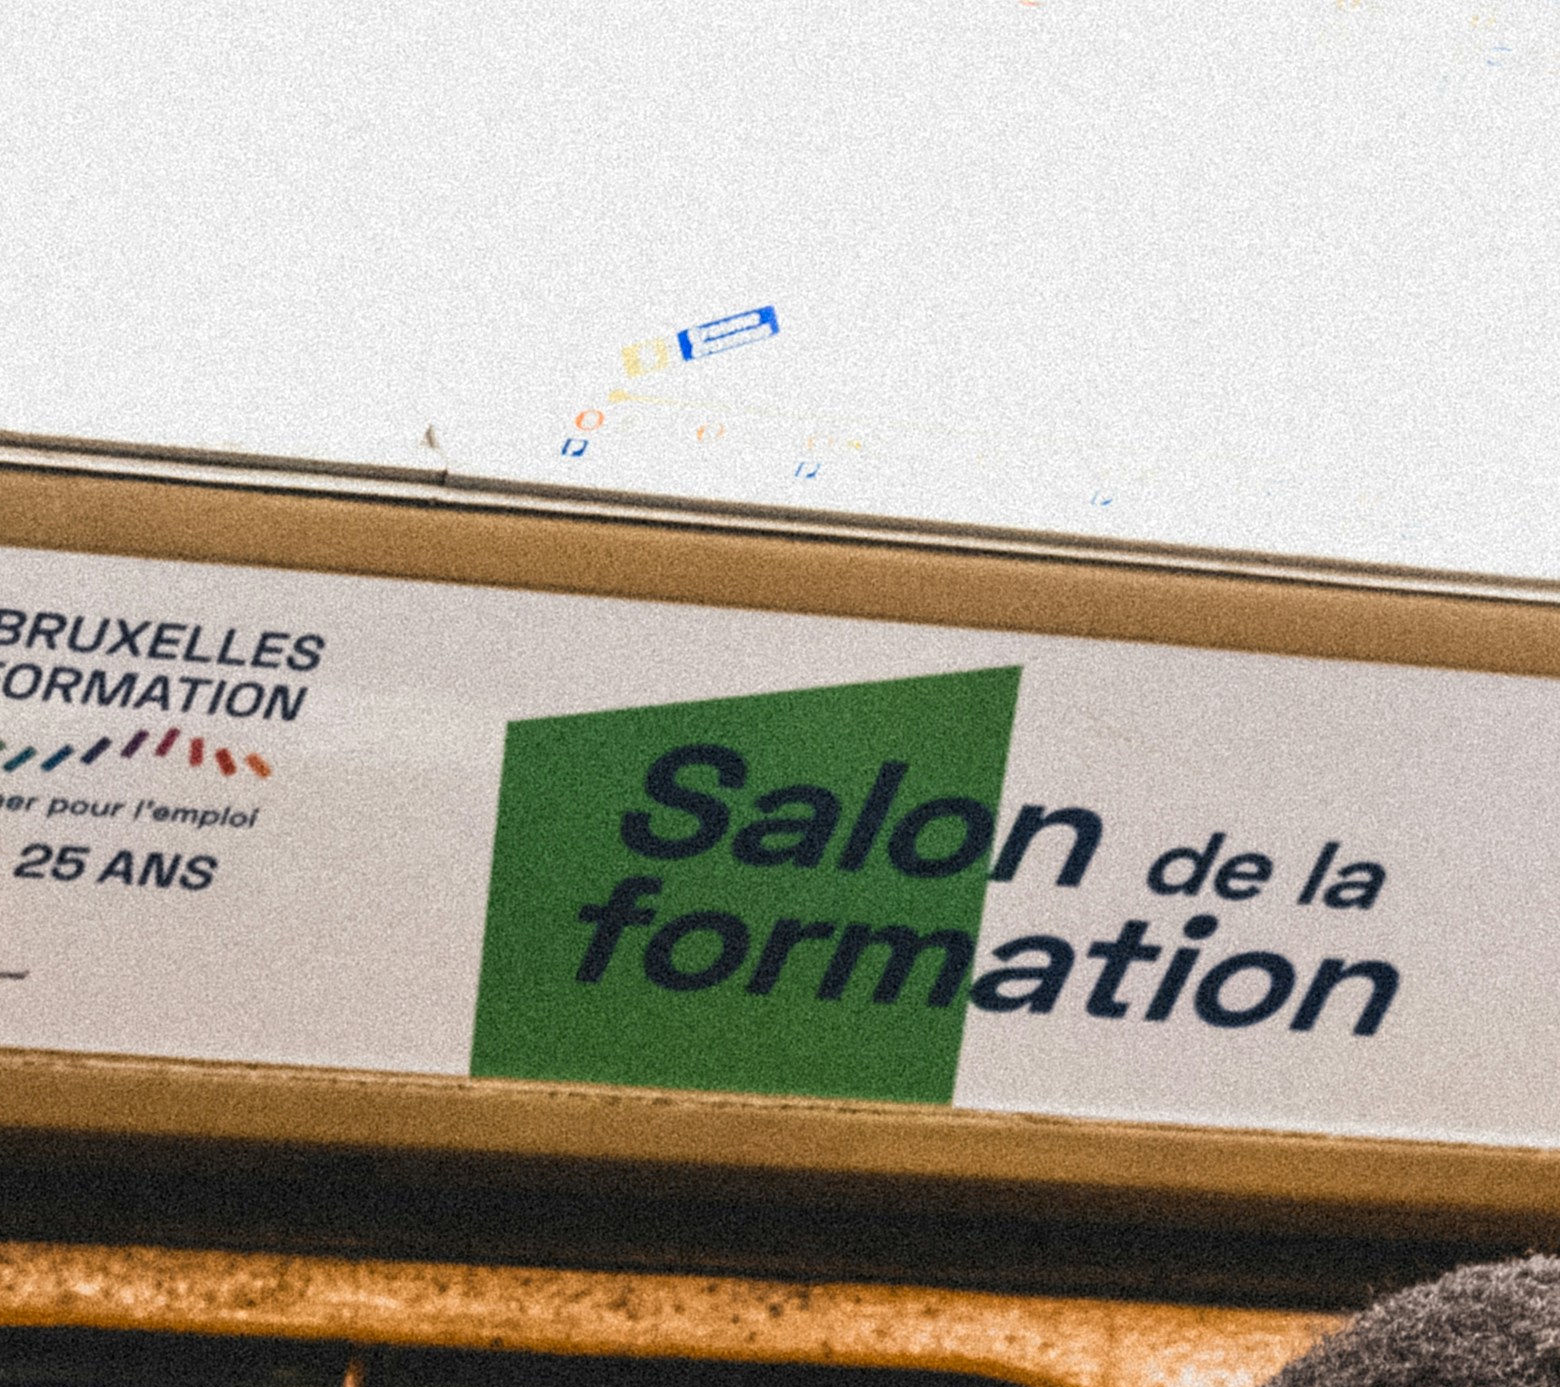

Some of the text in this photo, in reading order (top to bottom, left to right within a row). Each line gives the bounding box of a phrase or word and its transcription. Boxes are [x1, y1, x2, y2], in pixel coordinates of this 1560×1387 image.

[46, 796, 125, 818] pour
[134, 799, 260, 830] l'emploi
[618, 743, 1387, 911] Salon de la
[12, 841, 219, 891] 25 ANS
[575, 876, 1400, 1037] formation
